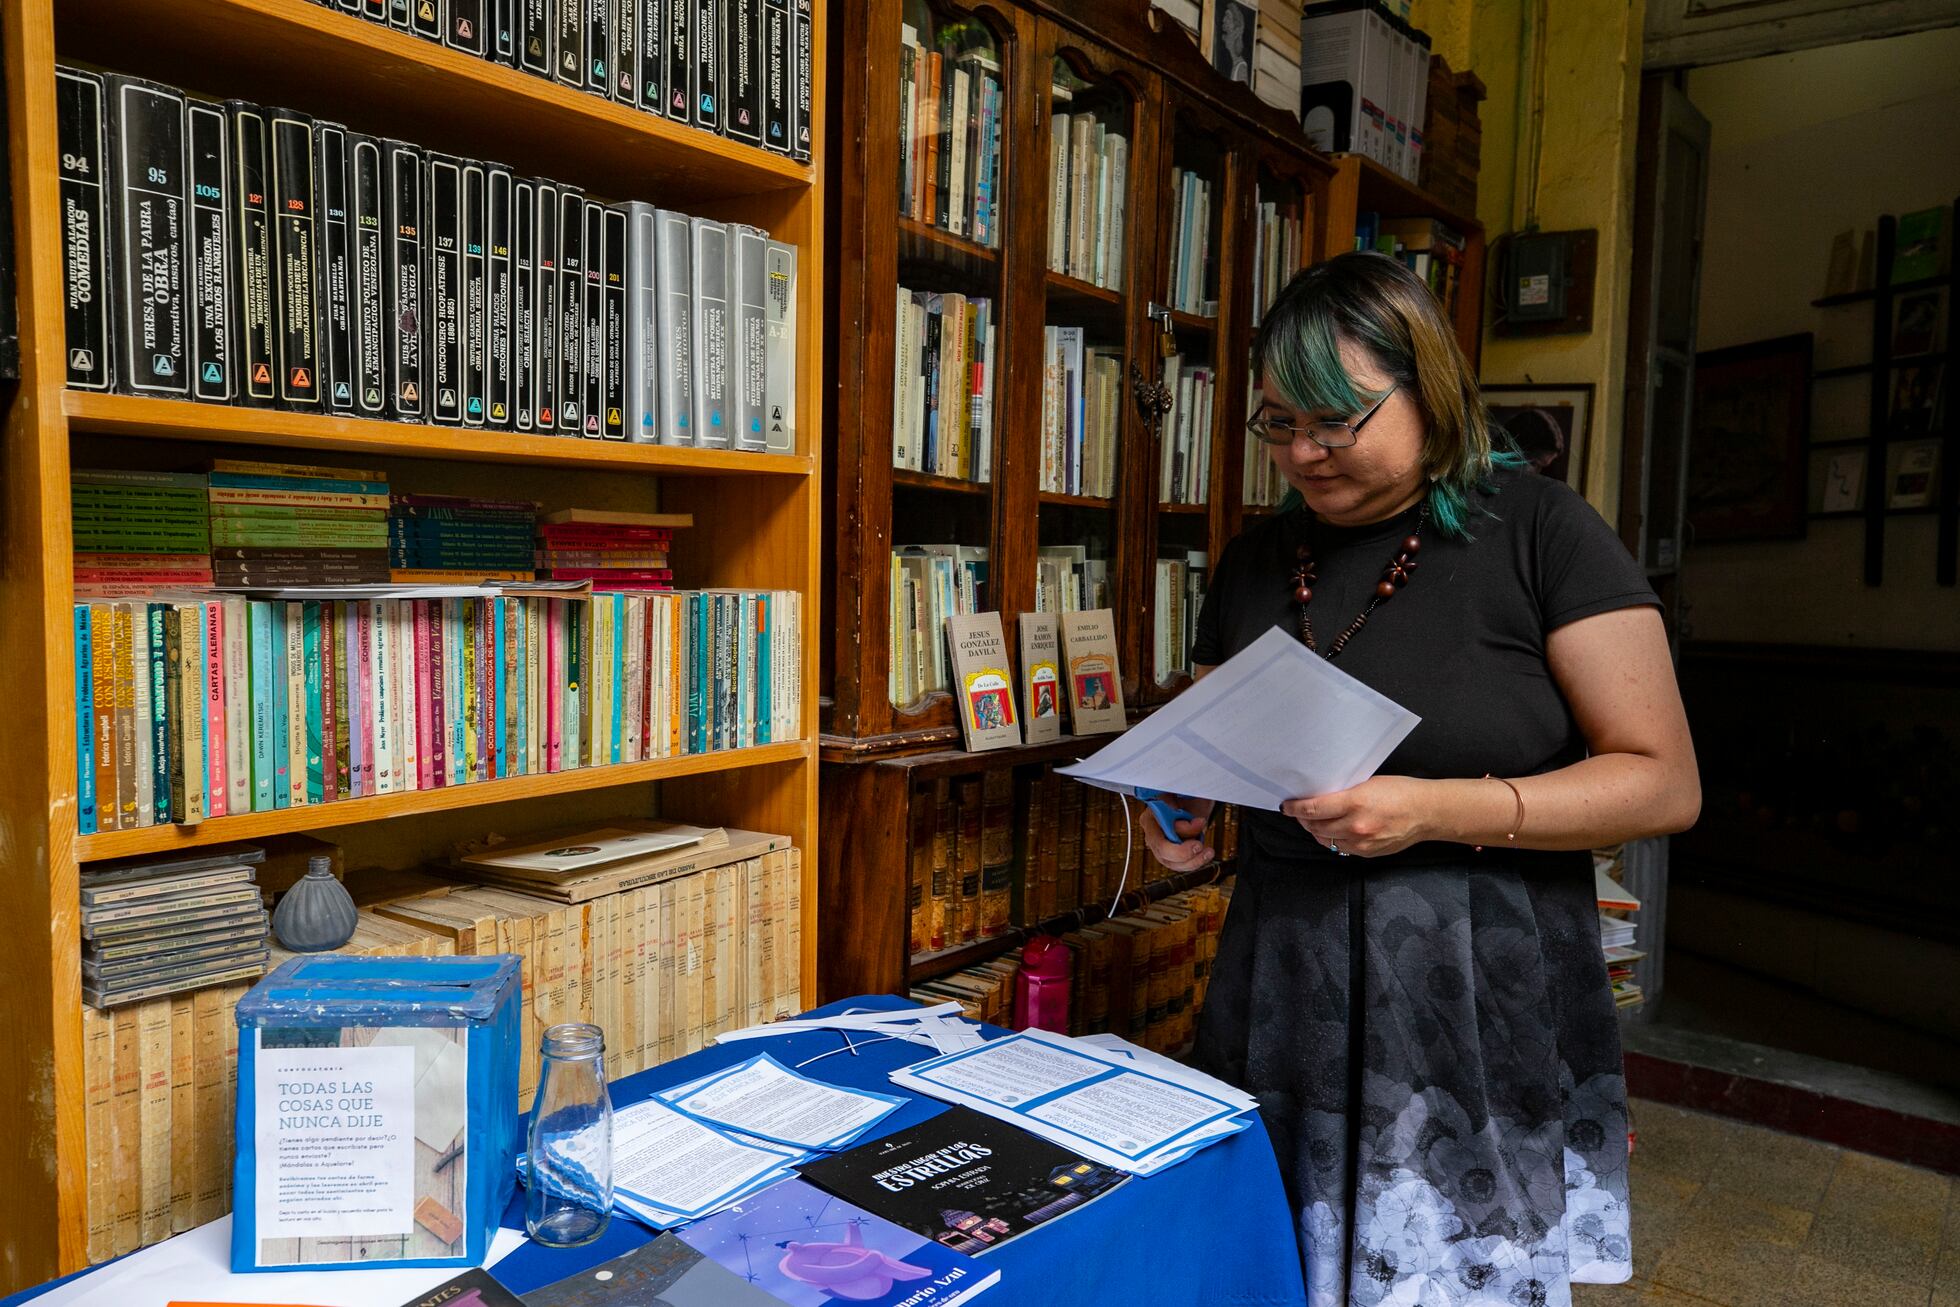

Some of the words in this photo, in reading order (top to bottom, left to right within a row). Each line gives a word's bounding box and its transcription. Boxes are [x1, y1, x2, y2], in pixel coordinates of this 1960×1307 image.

[63, 153, 89, 173] 94
[148, 167, 166, 184] 95
[196, 184, 221, 198] 105
[249, 193, 262, 204] 127
[288, 199, 304, 210] 128
[329, 209, 344, 217] 130
[67, 198, 76, 243] ALARCON
[139, 200, 152, 248] PARRA
[166, 198, 178, 237] cartas)
[360, 216, 377, 225] 133
[400, 225, 416, 236] 135
[69, 243, 76, 257] DE
[212, 214, 222, 283] RANQUELES
[362, 245, 369, 259] DE
[438, 237, 454, 247] 137
[494, 247, 507, 255] 146
[76, 209, 92, 302] COMEDIAS
[141, 251, 153, 270] LA
[168, 240, 179, 290] ensayos,
[255, 254, 261, 265] UN
[294, 259, 300, 271] UN
[369, 235, 377, 296] VENEZOLANA
[567, 258, 578, 267] 187
[69, 259, 77, 282] RUIZ
[153, 248, 169, 304] OBRA
[204, 237, 213, 301] EXCURSION
[256, 267, 262, 278] DE
[295, 272, 301, 283] DE
[587, 271, 599, 281] 200
[142, 273, 153, 292] DE
[363, 260, 371, 304] POLITICO
[437, 255, 446, 318] RIOPLATENSE
[70, 283, 78, 309] JUAN
[214, 286, 223, 325] INDIOS
[295, 284, 303, 329] MEMORIAS
[143, 298, 155, 349] TERESA
[170, 293, 181, 357] (Narrativa,
[206, 305, 214, 329] UNA
[447, 298, 456, 344] (1880-1925)
[215, 328, 224, 350] LOS
[364, 306, 372, 374] PENSAMIENTO
[217, 352, 224, 361] A
[439, 321, 447, 383] CANCIONERO
[372, 373, 379, 385] LA
[184, 612, 192, 651] CUATRO
[191, 610, 200, 643] INDIAS
[210, 606, 218, 658] ALEMANAS
[969, 631, 991, 639] JESUS
[102, 612, 112, 680] ESCRITORES
[124, 613, 133, 680] ESCRITORES
[432, 640, 440, 652] los
[961, 639, 1000, 649] GONZALEZ
[968, 649, 996, 657] DAVILA
[1031, 641, 1054, 650] ENRIQUEZ
[92, 609, 103, 708] CONVERSACIONES
[115, 611, 125, 708] CONVERSACIONES
[192, 649, 200, 661] DE
[433, 655, 440, 665] de
[433, 669, 442, 700] Vientos
[104, 686, 114, 707] CON
[125, 686, 134, 707] CON
[193, 666, 201, 740] HISTORIADORES
[100, 715, 109, 741] Campbell
[122, 715, 131, 741] Campbell
[325, 716, 331, 724] El
[102, 743, 110, 767] Federico
[124, 743, 132, 766] Federico
[278, 1082, 337, 1095] TODAS
[342, 1081, 373, 1093] LAS
[279, 1099, 333, 1112] COSAS
[338, 1098, 373, 1111] QUE
[279, 1116, 341, 1129] NUNCA
[347, 1115, 383, 1127] DIJE
[878, 1143, 992, 1192] ESTRELLAS
[909, 1152, 938, 1167] LUGAR
